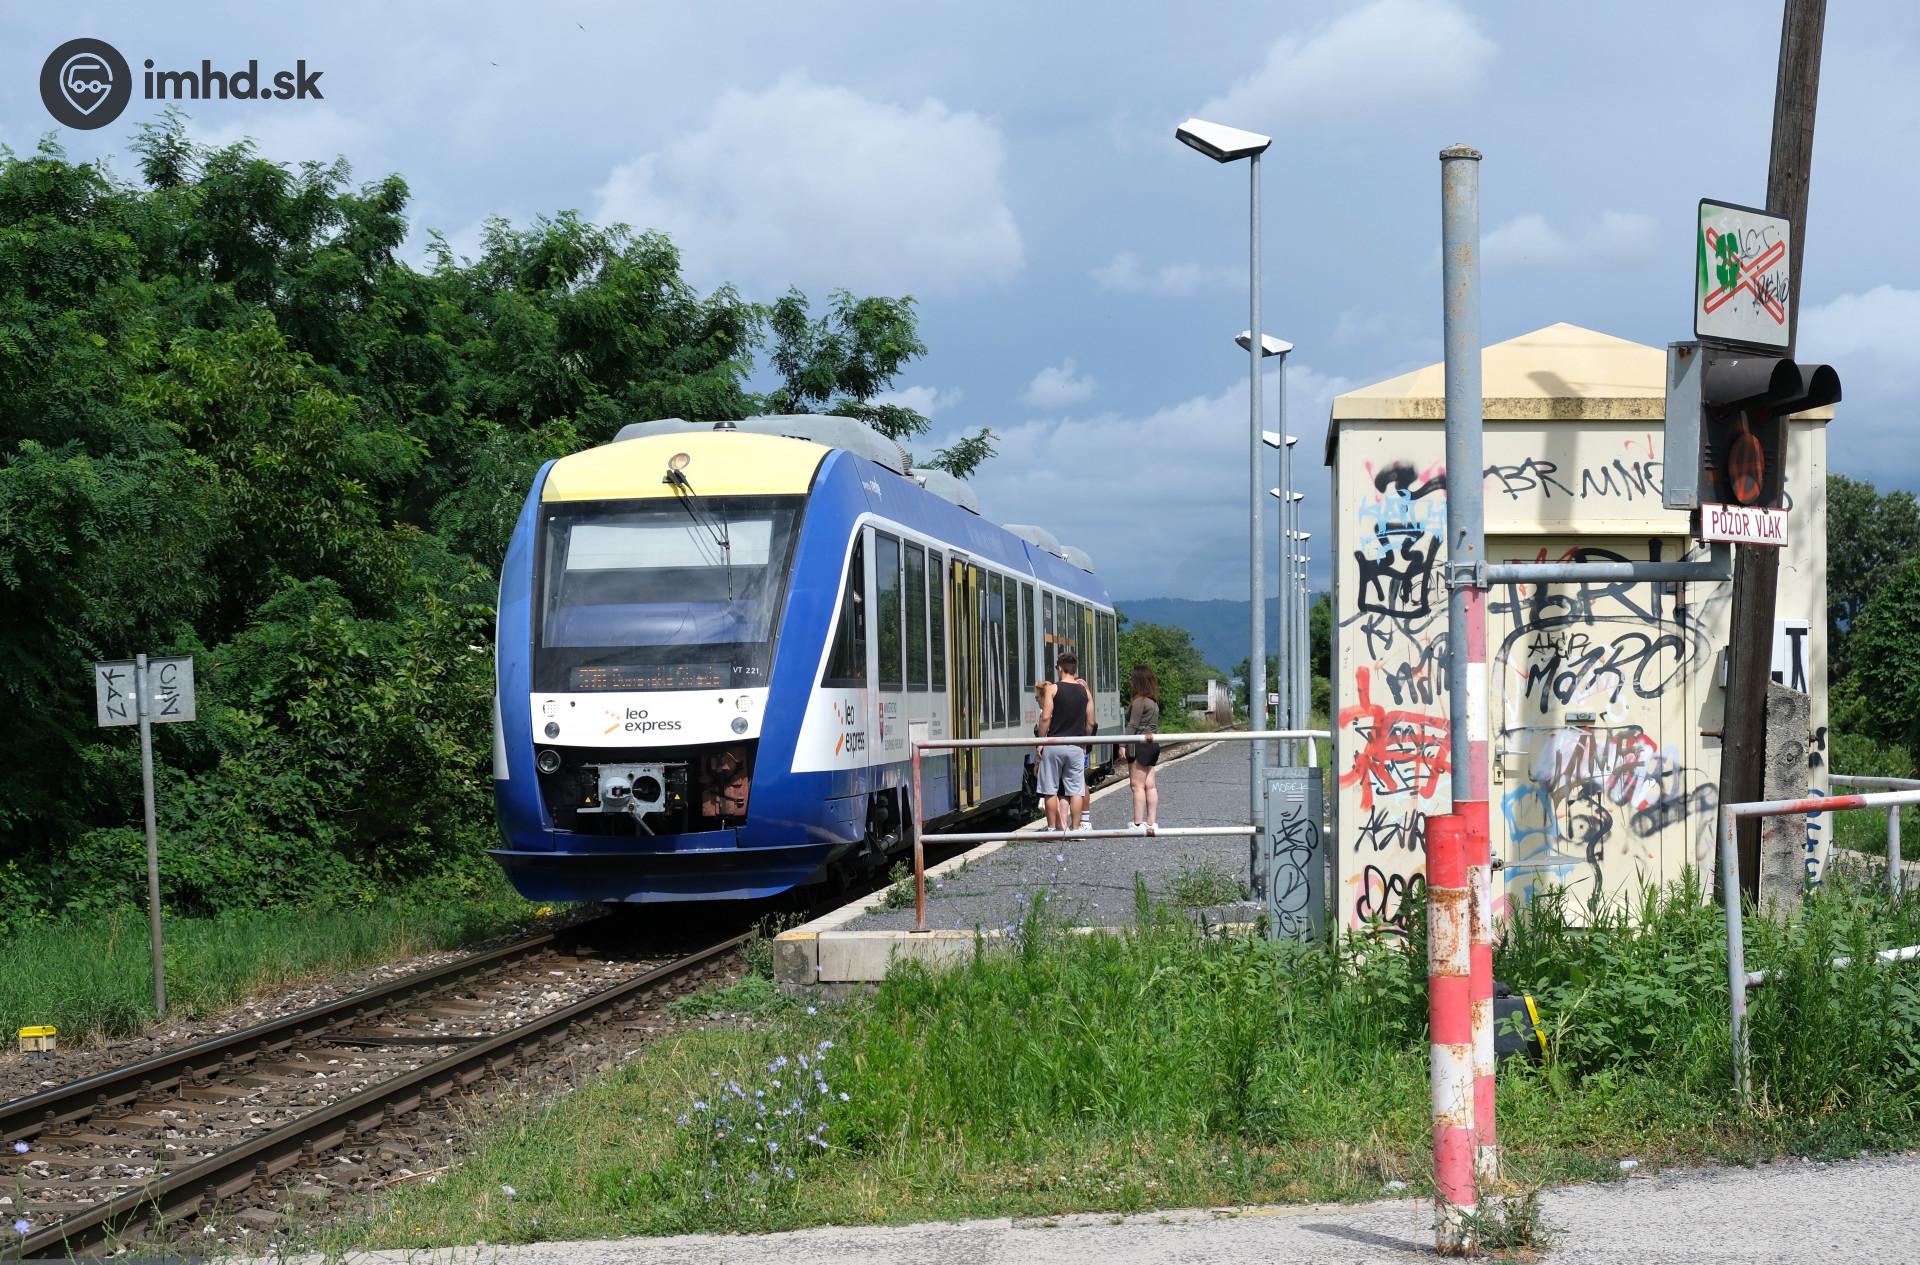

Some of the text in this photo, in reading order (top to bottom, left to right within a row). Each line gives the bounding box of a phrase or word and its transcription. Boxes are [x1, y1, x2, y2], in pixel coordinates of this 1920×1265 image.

[1711, 510, 1782, 539] POZOR VLAK
[733, 666, 743, 674] VT
[626, 707, 649, 720] leo
[845, 698, 855, 726] leo
[624, 720, 682, 734] express
[845, 731, 865, 759] express
